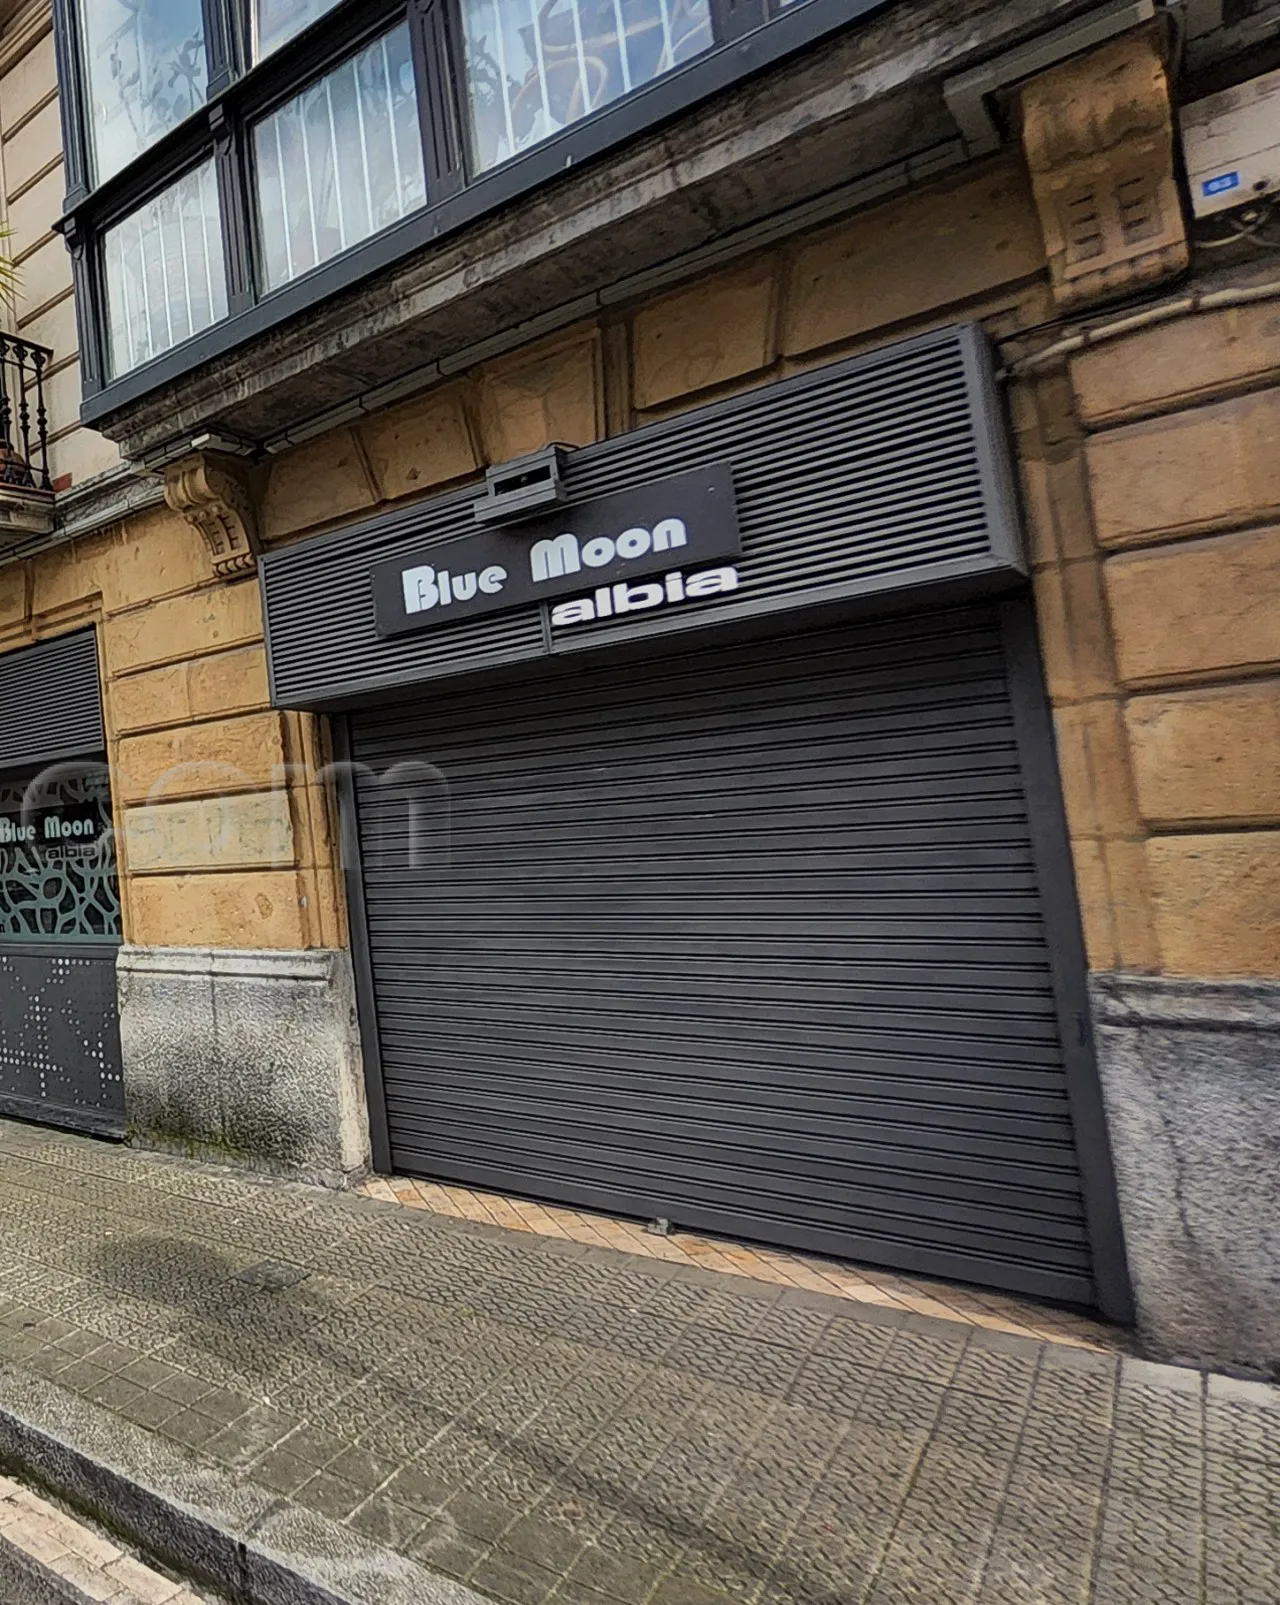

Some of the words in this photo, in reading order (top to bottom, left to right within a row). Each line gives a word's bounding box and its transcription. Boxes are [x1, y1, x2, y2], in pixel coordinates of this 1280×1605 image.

[401, 564, 507, 615] Blue
[529, 517, 687, 583] Moon
[551, 566, 739, 626] albia
[44, 815, 95, 839] Moon
[47, 845, 97, 860] albia
